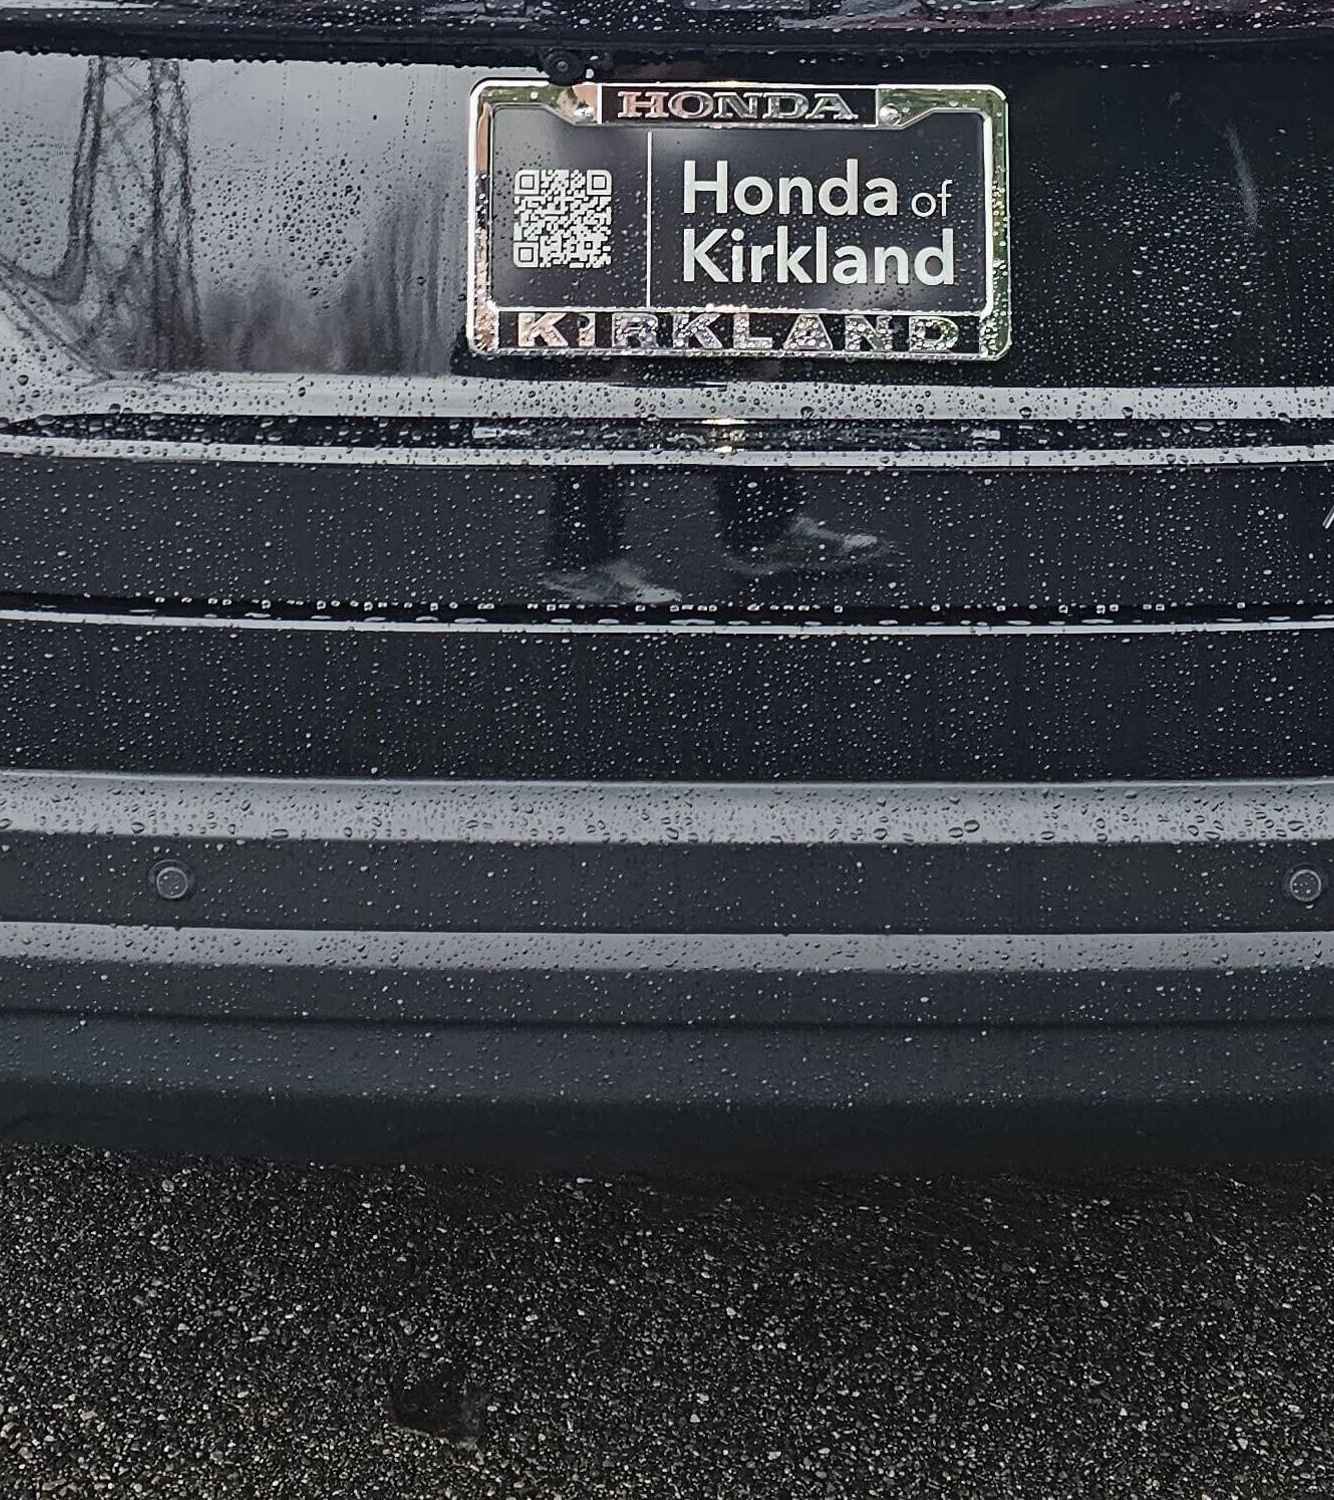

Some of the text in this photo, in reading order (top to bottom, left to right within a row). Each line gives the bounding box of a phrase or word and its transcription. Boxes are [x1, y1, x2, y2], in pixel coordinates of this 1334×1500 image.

[616, 90, 859, 121] HONDA
[682, 159, 954, 218] Honda of
[682, 226, 954, 285] Kirkland
[516, 312, 960, 351] KIRKLAND
